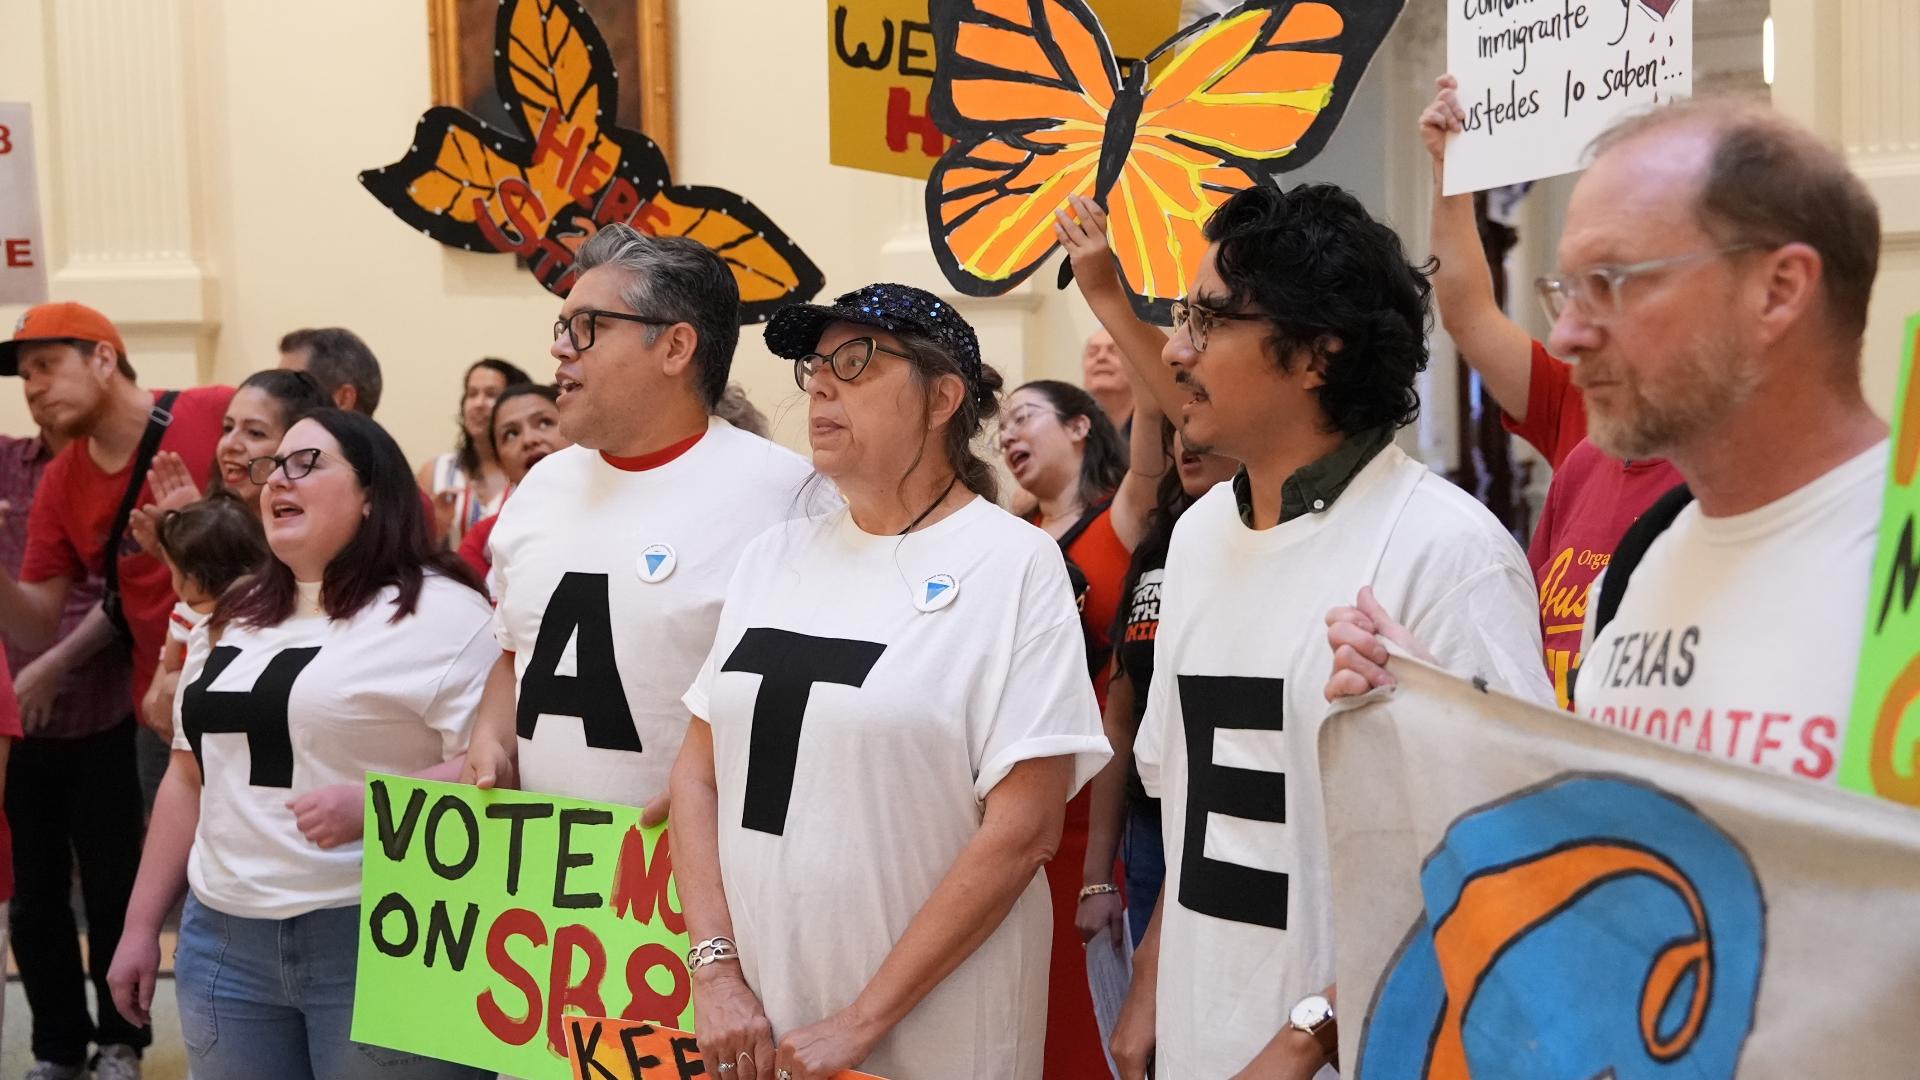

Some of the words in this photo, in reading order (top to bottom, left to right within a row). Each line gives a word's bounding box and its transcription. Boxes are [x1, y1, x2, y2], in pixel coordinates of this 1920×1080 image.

[1462, 80, 1540, 135] ustedes
[1564, 70, 1585, 117] lo
[1478, 0, 1589, 75] inmigrante
[182, 645, 322, 788] H
[516, 571, 643, 753] A
[1601, 625, 1702, 688] TEXAS
[720, 628, 888, 837] T
[370, 779, 614, 909] VOTE
[1177, 674, 1289, 930] E
[369, 892, 480, 972] ON
